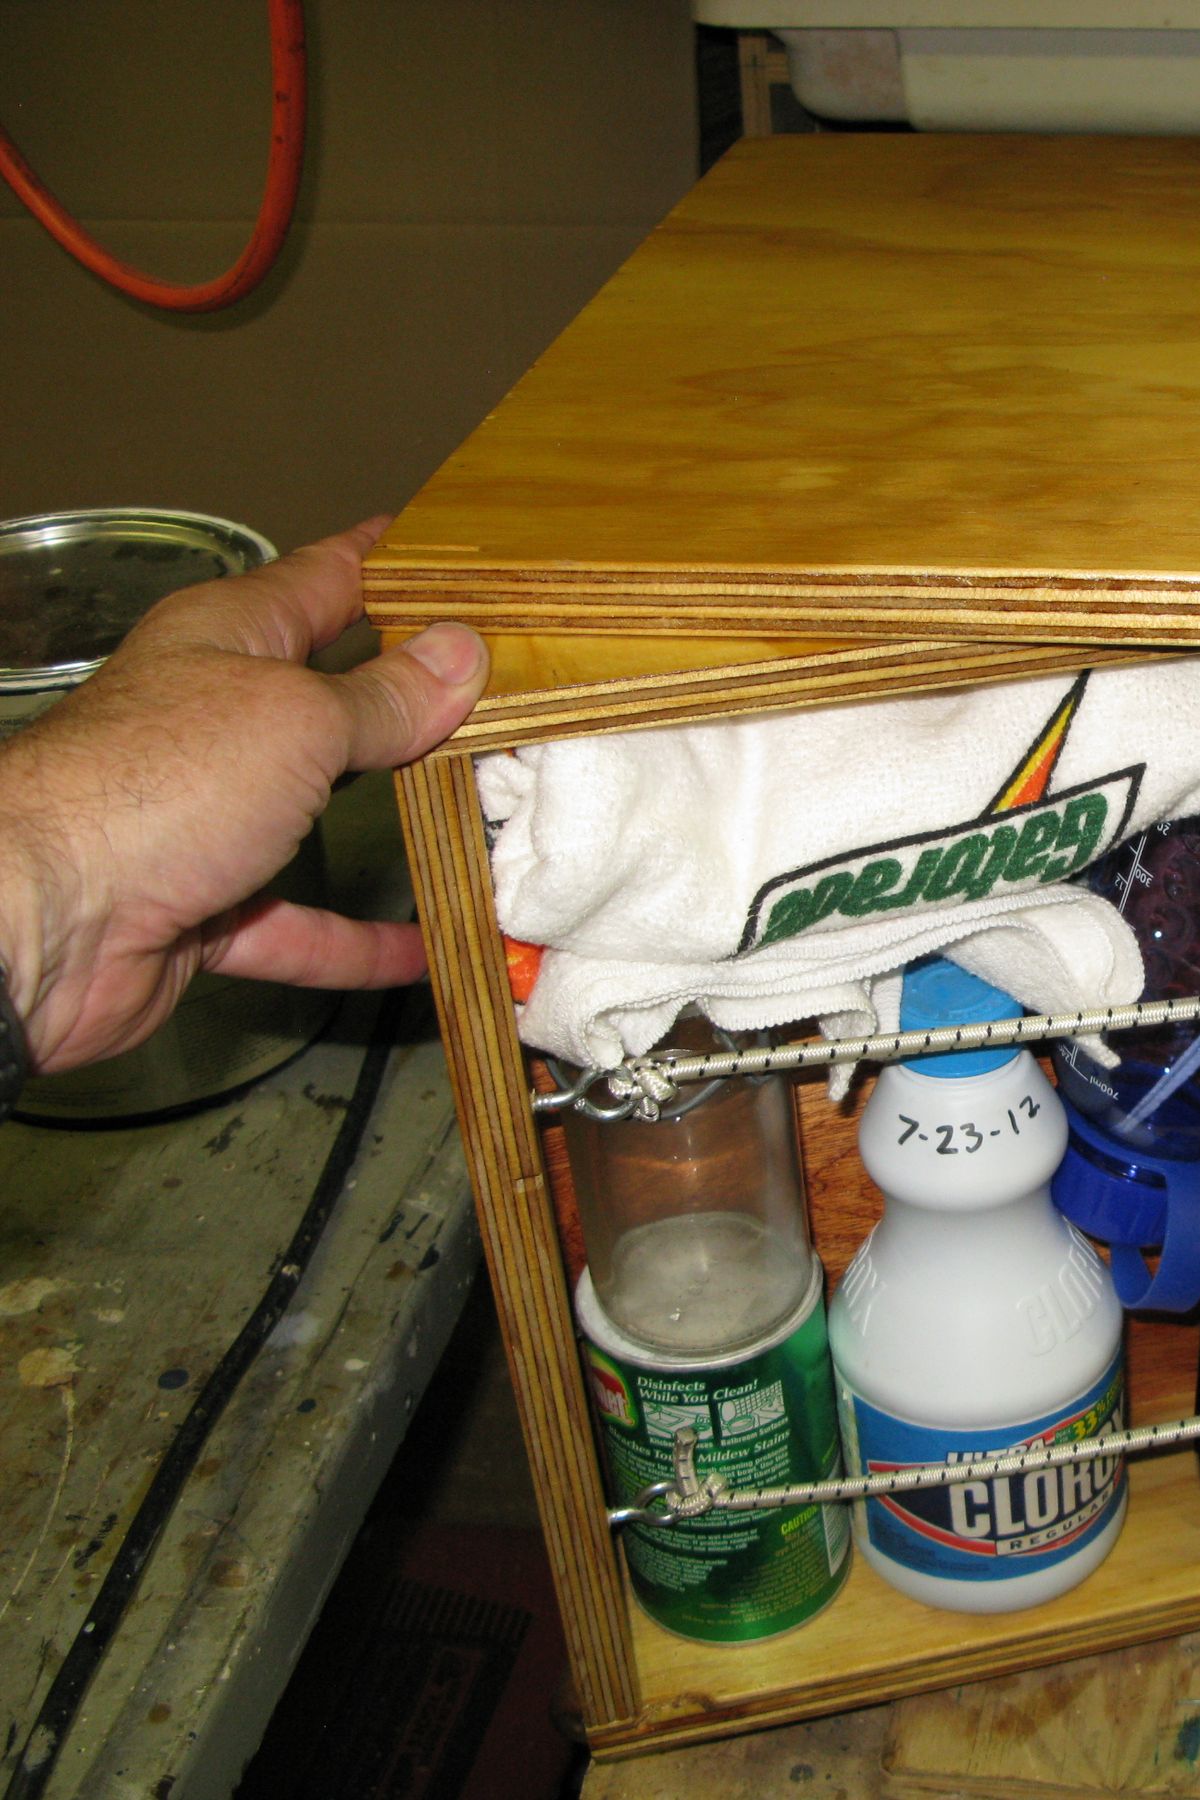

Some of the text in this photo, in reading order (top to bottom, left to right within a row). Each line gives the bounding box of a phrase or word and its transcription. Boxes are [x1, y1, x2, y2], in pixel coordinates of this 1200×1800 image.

[759, 792, 1108, 948] Gatorade
[1135, 867, 1152, 888] 300
[1114, 876, 1124, 891] 12
[1089, 1075, 1120, 1101] 700ml
[897, 1095, 1041, 1155] 7-23-12
[636, 1376, 706, 1392] Disinfects
[639, 1378, 759, 1403] While You Clean!
[654, 1450, 674, 1462] Tou
[697, 1447, 750, 1464] Mildew
[753, 1429, 792, 1453] Stains
[1009, 1490, 1111, 1551] REGULAR
